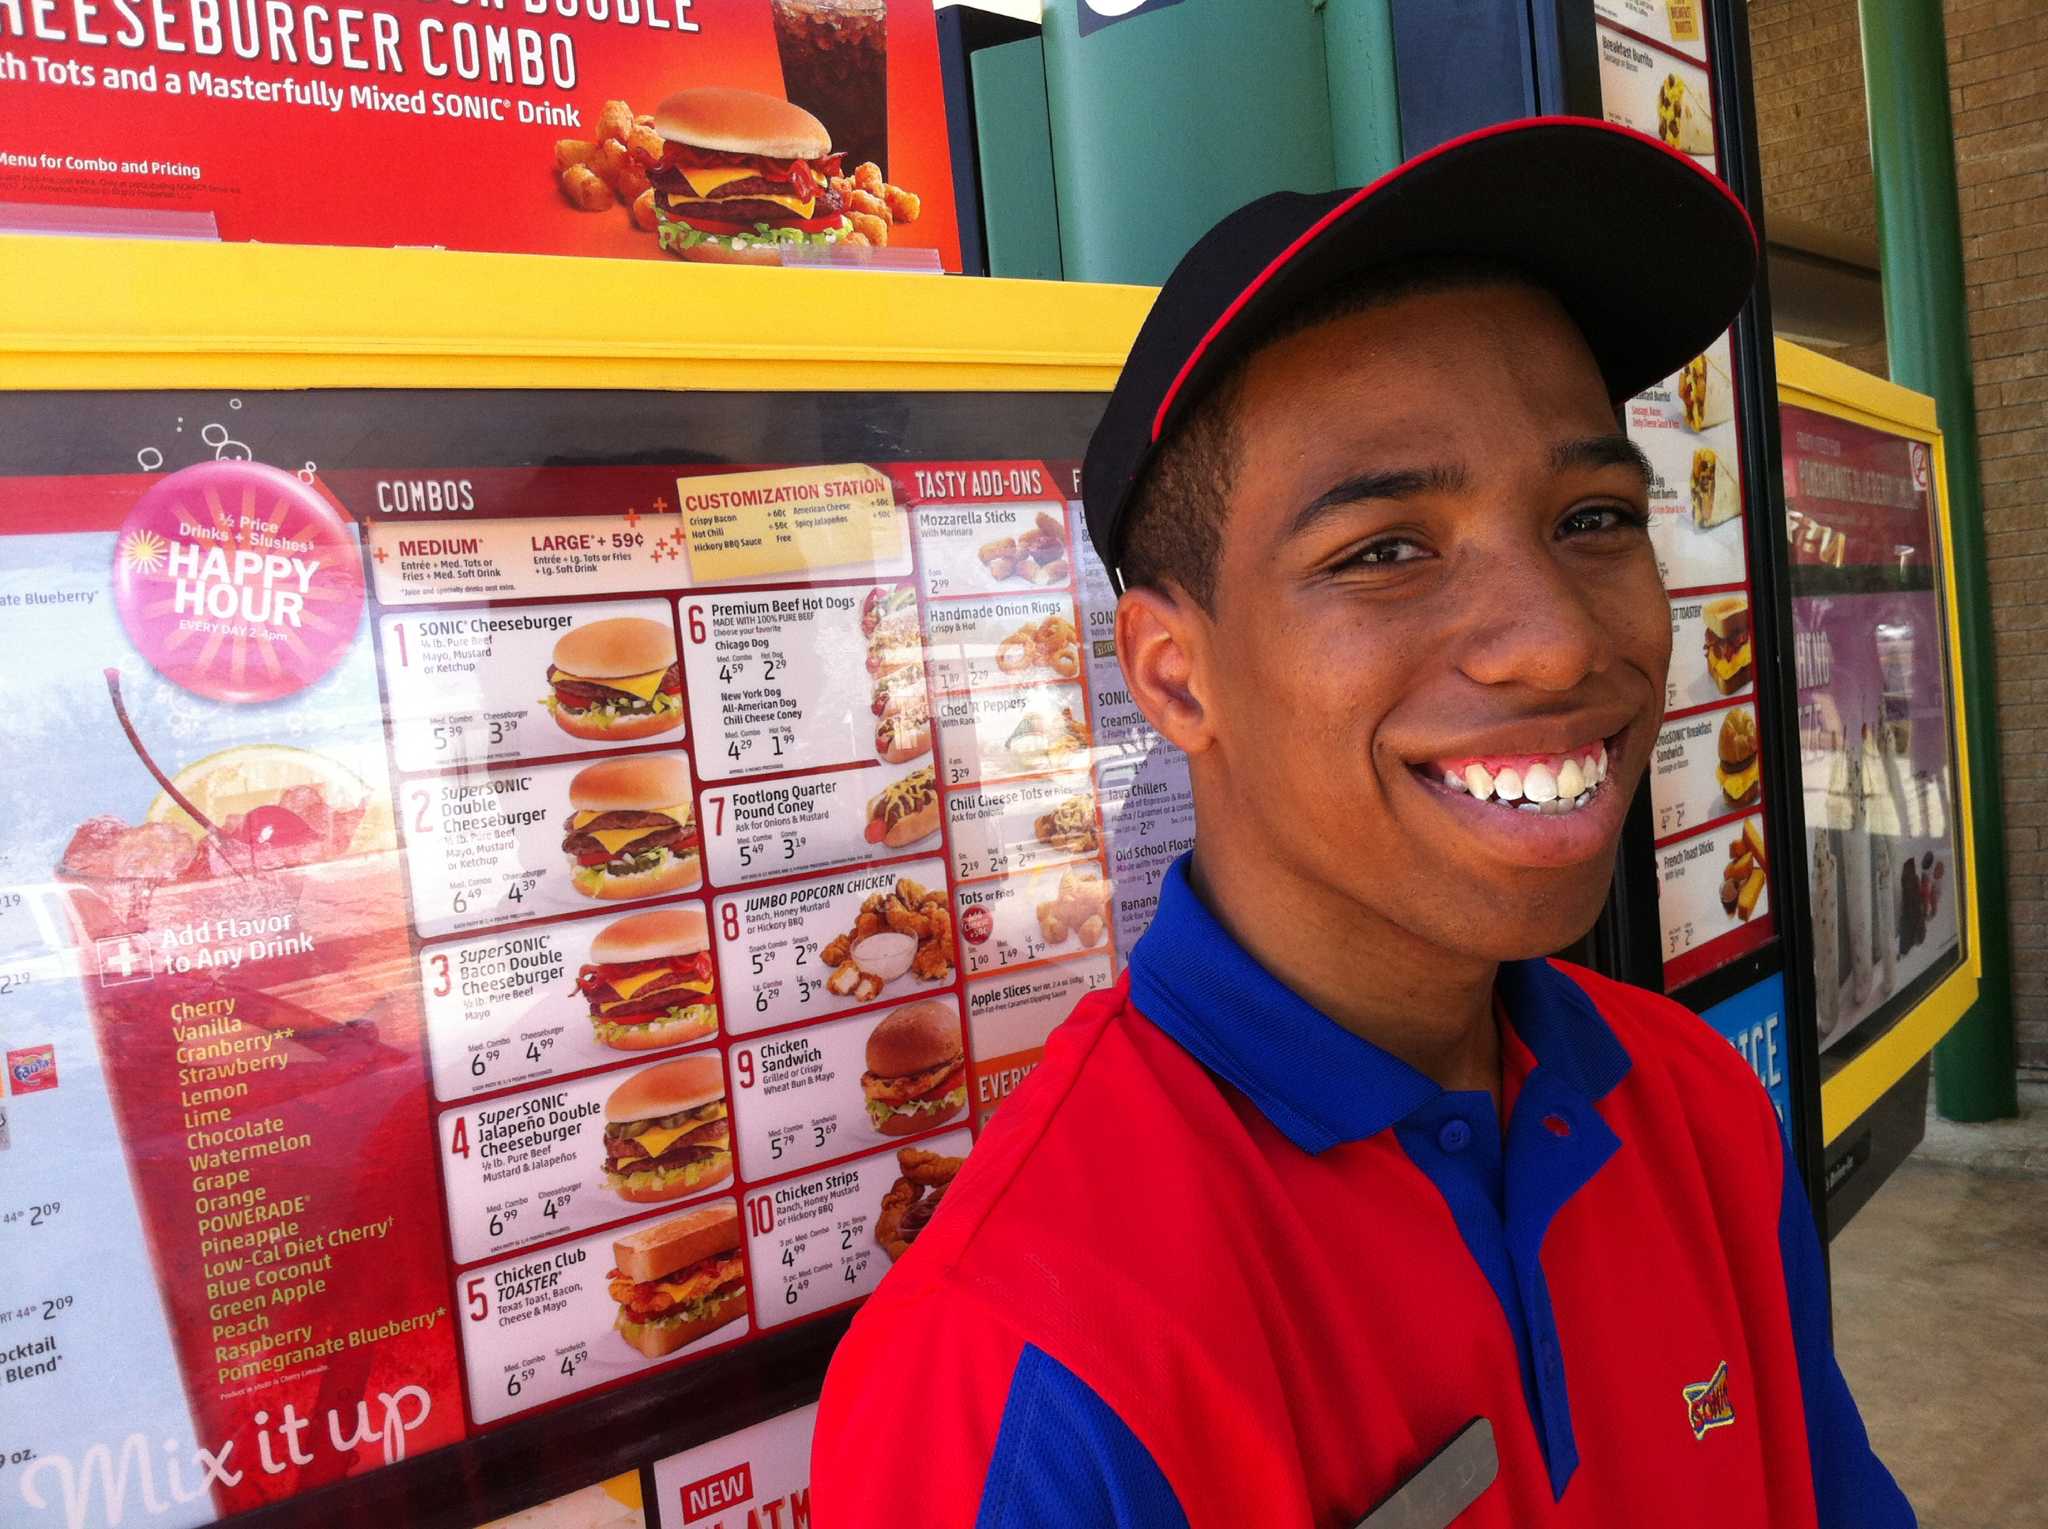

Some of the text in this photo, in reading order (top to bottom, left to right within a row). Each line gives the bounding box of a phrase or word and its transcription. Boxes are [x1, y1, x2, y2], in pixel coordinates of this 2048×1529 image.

[419, 18, 576, 89] COMBO
[31, 56, 96, 87] Tots
[103, 65, 158, 92] and
[165, 72, 181, 94] a
[187, 70, 344, 113] Masterfully
[350, 85, 426, 115] Mixed
[518, 100, 581, 128] Drink
[40, 153, 62, 169] for
[65, 157, 117, 173] Combo
[121, 160, 148, 175] and
[152, 161, 200, 179] Pricing
[376, 479, 475, 513] COMBOS
[685, 478, 886, 512] CUSTOMIZATION STATION
[915, 469, 1043, 498] TASTY ADD-ONS
[179, 522, 230, 542] Drinks
[239, 515, 279, 534] Price
[920, 511, 1016, 527] Mozzarella Sticks
[168, 541, 320, 594] HAPPY
[174, 578, 304, 628] HOUR
[930, 601, 1061, 622] Handmade Onion Rings
[179, 619, 218, 633] EVERY
[221, 621, 247, 636] DAY
[688, 596, 856, 645] 6 Premium Beef Hot Dogs
[393, 623, 409, 668] 1
[470, 615, 573, 633] Cheeseburger
[715, 638, 770, 652] Chicago Dog
[721, 688, 782, 702] New York Dog
[722, 699, 797, 714] All-American Dog
[950, 788, 1042, 812] Chili Cheese Tots
[1131, 781, 1168, 797] Chillers
[411, 789, 547, 834] 2 Cheeseburger
[442, 799, 497, 817] Double
[709, 781, 838, 837] 7 Footlong Quarter
[734, 800, 815, 821] Pound Coney
[1115, 842, 1168, 862] Old School
[721, 902, 740, 941] 8
[744, 893, 788, 913] JUMBO
[790, 883, 845, 904] POPCORN
[960, 892, 983, 906] Tots
[162, 914, 293, 949] Add Flavor
[165, 932, 315, 975] to Any Drink
[431, 949, 563, 998] 3 Bacon Double
[462, 964, 566, 997] Cheeseburger
[170, 998, 236, 1021] Cherry
[971, 983, 1031, 1008] Apple Slices
[172, 1017, 242, 1043] Vanilla
[178, 1053, 288, 1086] Strawberry
[738, 1038, 809, 1089] 9 Chicken
[762, 1048, 822, 1074] Sandwich
[181, 1082, 249, 1108] Lemon
[184, 1107, 232, 1130] Lime
[187, 1118, 285, 1150] Chocolate
[478, 1101, 602, 1144] Jalapeño Double
[189, 1133, 312, 1172] Watermelon
[452, 1116, 470, 1160] 4
[480, 1123, 582, 1159] Cheeseburger
[192, 1169, 250, 1193] Grape
[483, 1168, 521, 1183] Mustard
[532, 1152, 578, 1172] Jalapeños
[196, 1187, 267, 1215] Orange
[747, 1170, 859, 1237] 10 Chicken Strips
[201, 1221, 300, 1257] Pineapple
[204, 1245, 281, 1280] Low-Cal
[285, 1234, 324, 1259] Diet
[206, 1254, 332, 1300] Blue Coconut
[467, 1248, 587, 1322] 5 Chicken Club
[209, 1278, 327, 1321] Green Apple
[498, 1301, 524, 1316] Texas
[553, 1283, 583, 1299] Bacon,
[499, 1312, 532, 1328] Cheese
[543, 1300, 567, 1317] Mayo
[212, 1314, 270, 1342] Peach
[215, 1325, 313, 1363] Raspberry
[218, 1337, 345, 1384] Pomegranate
[10, 1447, 37, 1466] oz.
[20, 1385, 431, 1529] Mix it up
[688, 1472, 745, 1515] NEW
